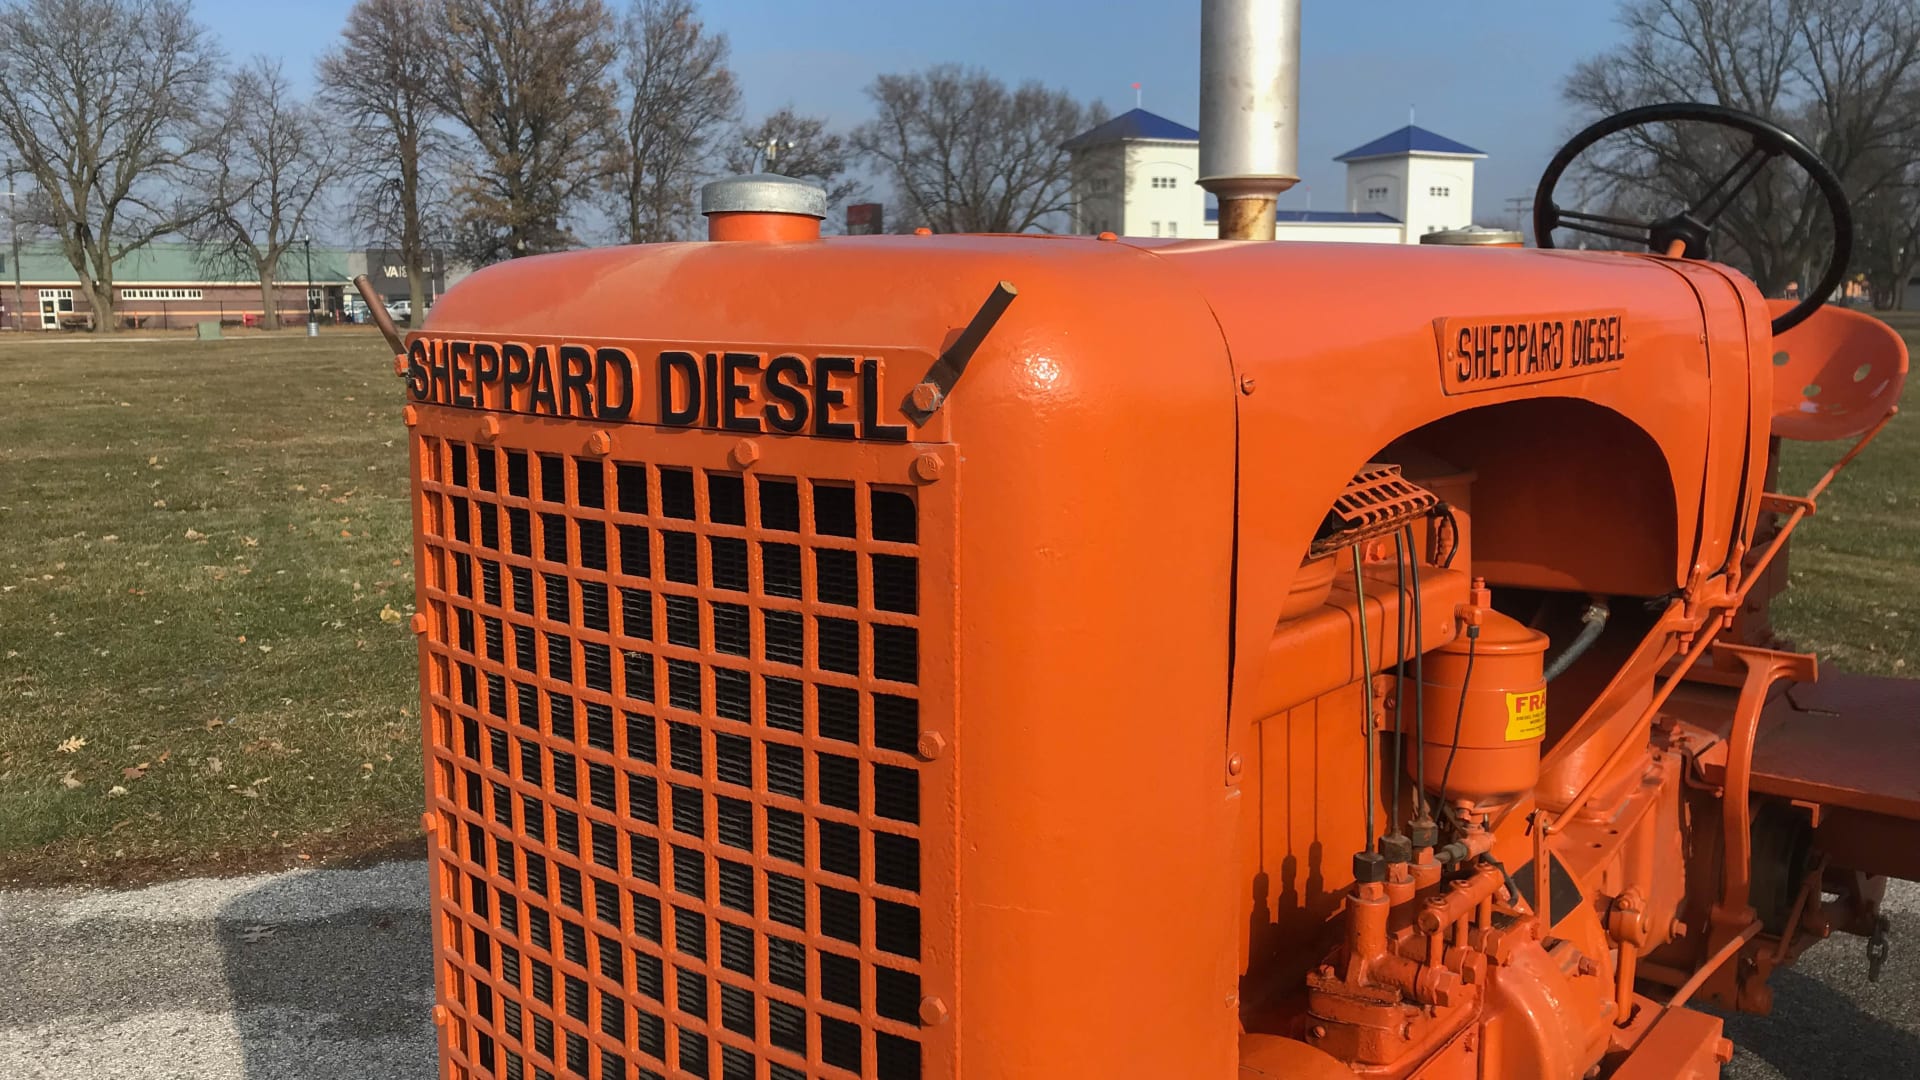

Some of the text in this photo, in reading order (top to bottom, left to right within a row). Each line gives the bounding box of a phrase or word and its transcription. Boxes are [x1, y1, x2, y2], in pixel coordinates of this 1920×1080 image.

[383, 265, 399, 278] VA
[1458, 316, 1625, 382] SHEPPARD DIESEL
[409, 338, 908, 441] SHEPPARD DIESEL
